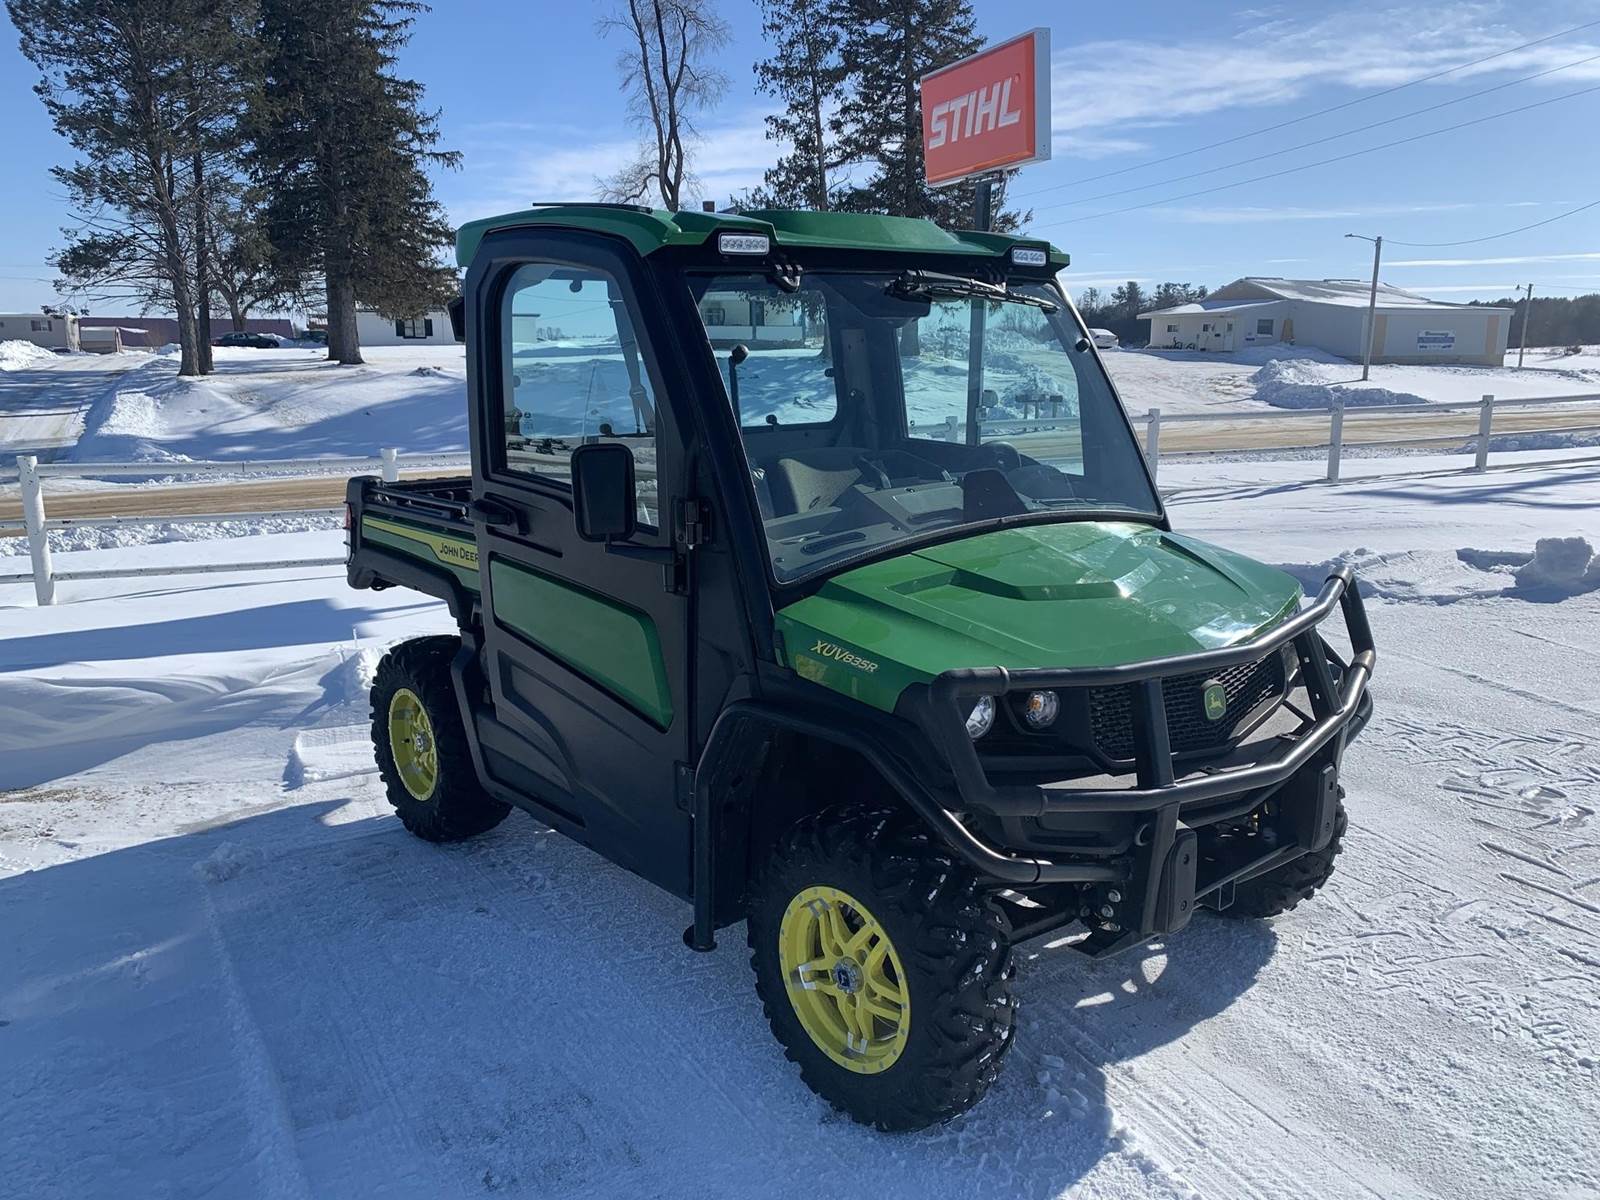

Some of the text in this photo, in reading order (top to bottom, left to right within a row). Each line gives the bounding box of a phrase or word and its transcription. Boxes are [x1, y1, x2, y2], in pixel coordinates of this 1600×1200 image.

[929, 77, 1021, 149] STIHL
[440, 542, 479, 562] JOHN DEER
[810, 640, 878, 673] XUV835R
